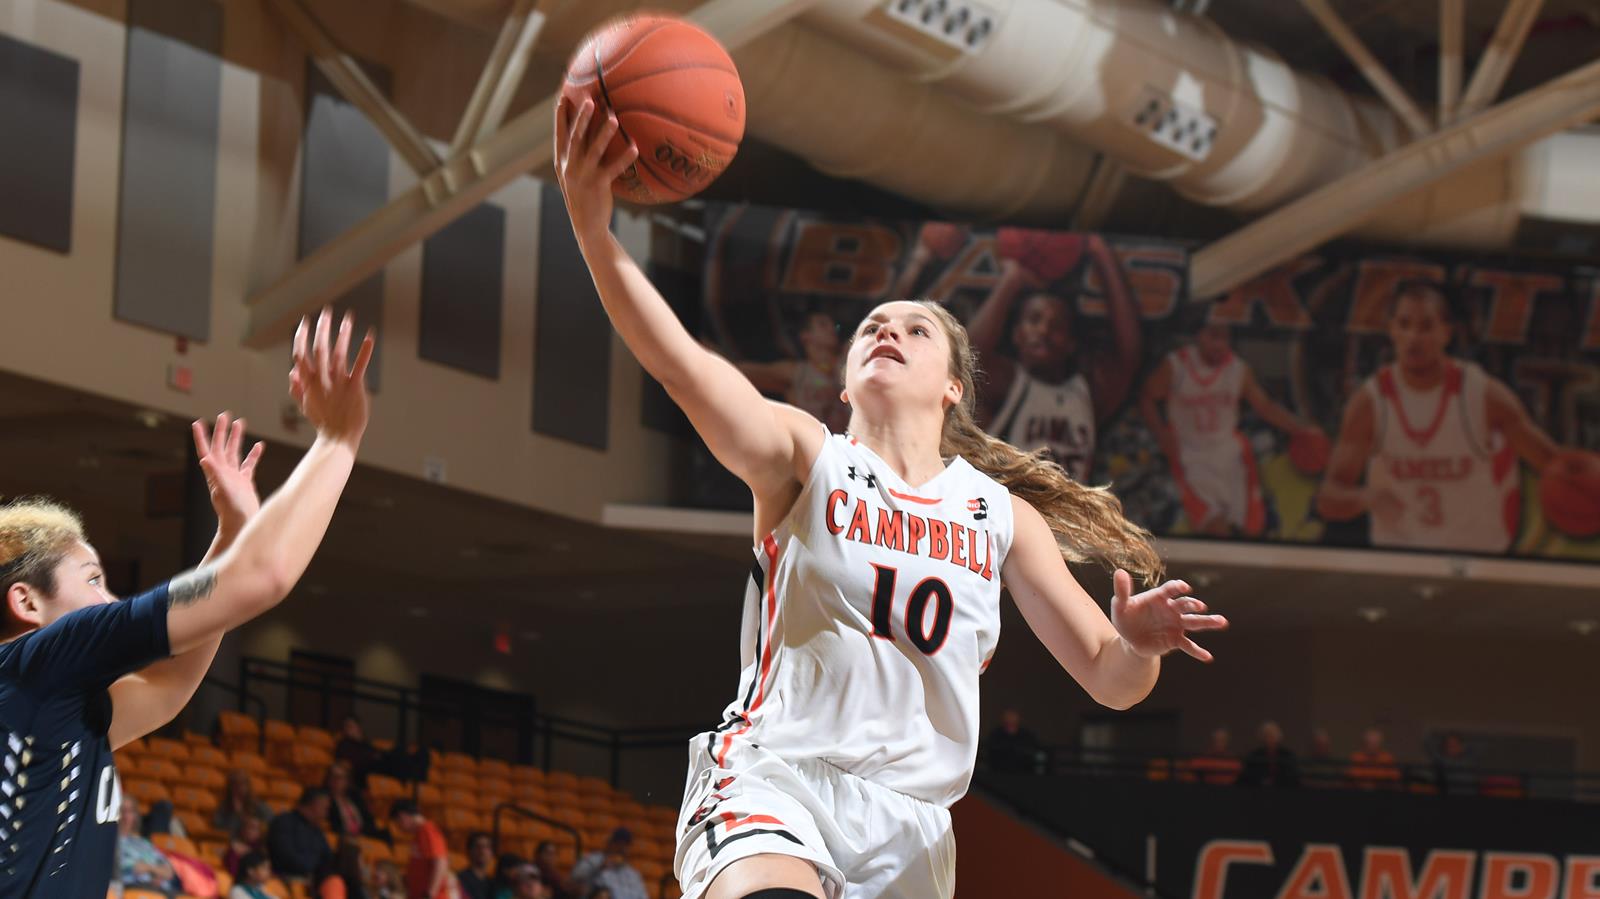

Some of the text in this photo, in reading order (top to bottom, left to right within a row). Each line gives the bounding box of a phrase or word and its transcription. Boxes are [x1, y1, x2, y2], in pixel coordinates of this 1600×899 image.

[781, 217, 1600, 348] BASKET
[825, 488, 993, 582] CAMPBELL
[867, 561, 954, 656] 10
